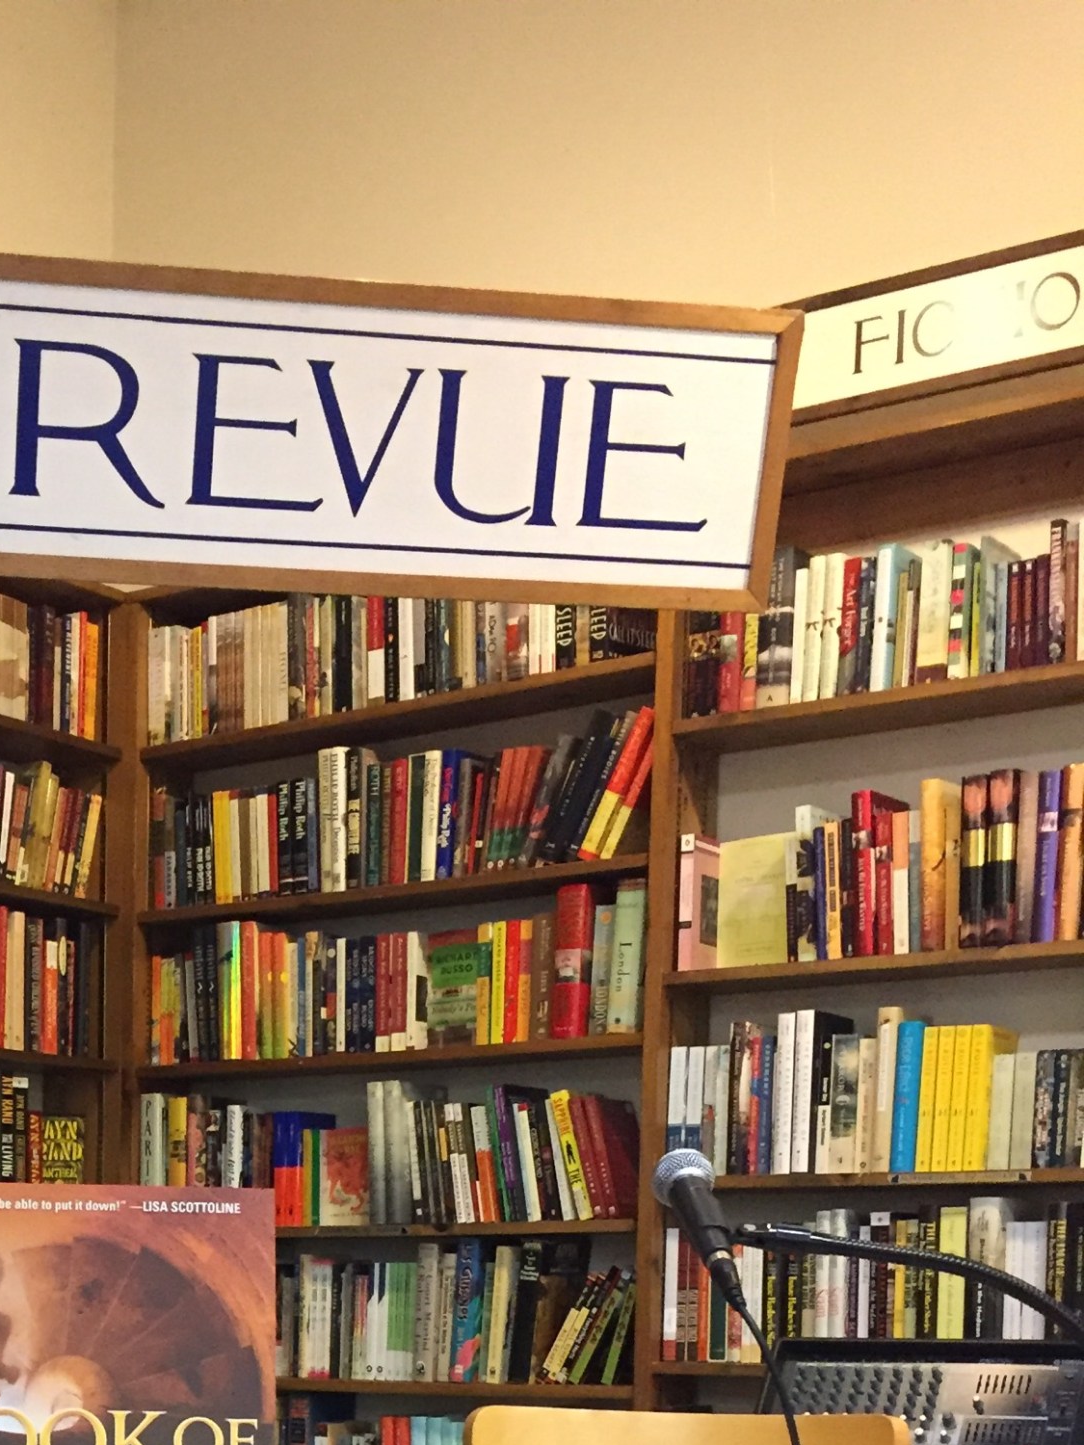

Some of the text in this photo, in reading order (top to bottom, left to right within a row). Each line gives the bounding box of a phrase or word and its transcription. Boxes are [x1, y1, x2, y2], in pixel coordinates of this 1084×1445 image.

[9, 338, 707, 532] REVUE
[555, 606, 573, 647] SLEEP
[589, 604, 607, 641] LEEP
[330, 752, 339, 791] PHILIP
[369, 765, 380, 797] ROTH
[277, 782, 290, 842] Philip Roth
[292, 780, 307, 841] Philip Roth
[331, 791, 340, 823] ROTH
[441, 963, 473, 975] RUSSO
[615, 941, 633, 993] London
[594, 985, 609, 1026] LONDON
[1, 1075, 14, 1096] AYN
[1, 1098, 14, 1125] RAND
[43, 1119, 78, 1140] AYN
[552, 1096, 582, 1185] SAPPHIRE THE
[1, 1144, 14, 1178] LIVING
[13, 1198, 39, 1211] able
[41, 1199, 53, 1211] to
[54, 1200, 74, 1214] put
[75, 1200, 84, 1212] it
[170, 1201, 242, 1215] SCOTTOLINE
[1055, 1219, 1068, 1239] THE
[766, 1275, 777, 1298] Isaac
[786, 1275, 798, 1298] Isaac
[572, 1316, 594, 1344] Everything
[975, 1305, 984, 1338] Hudson
